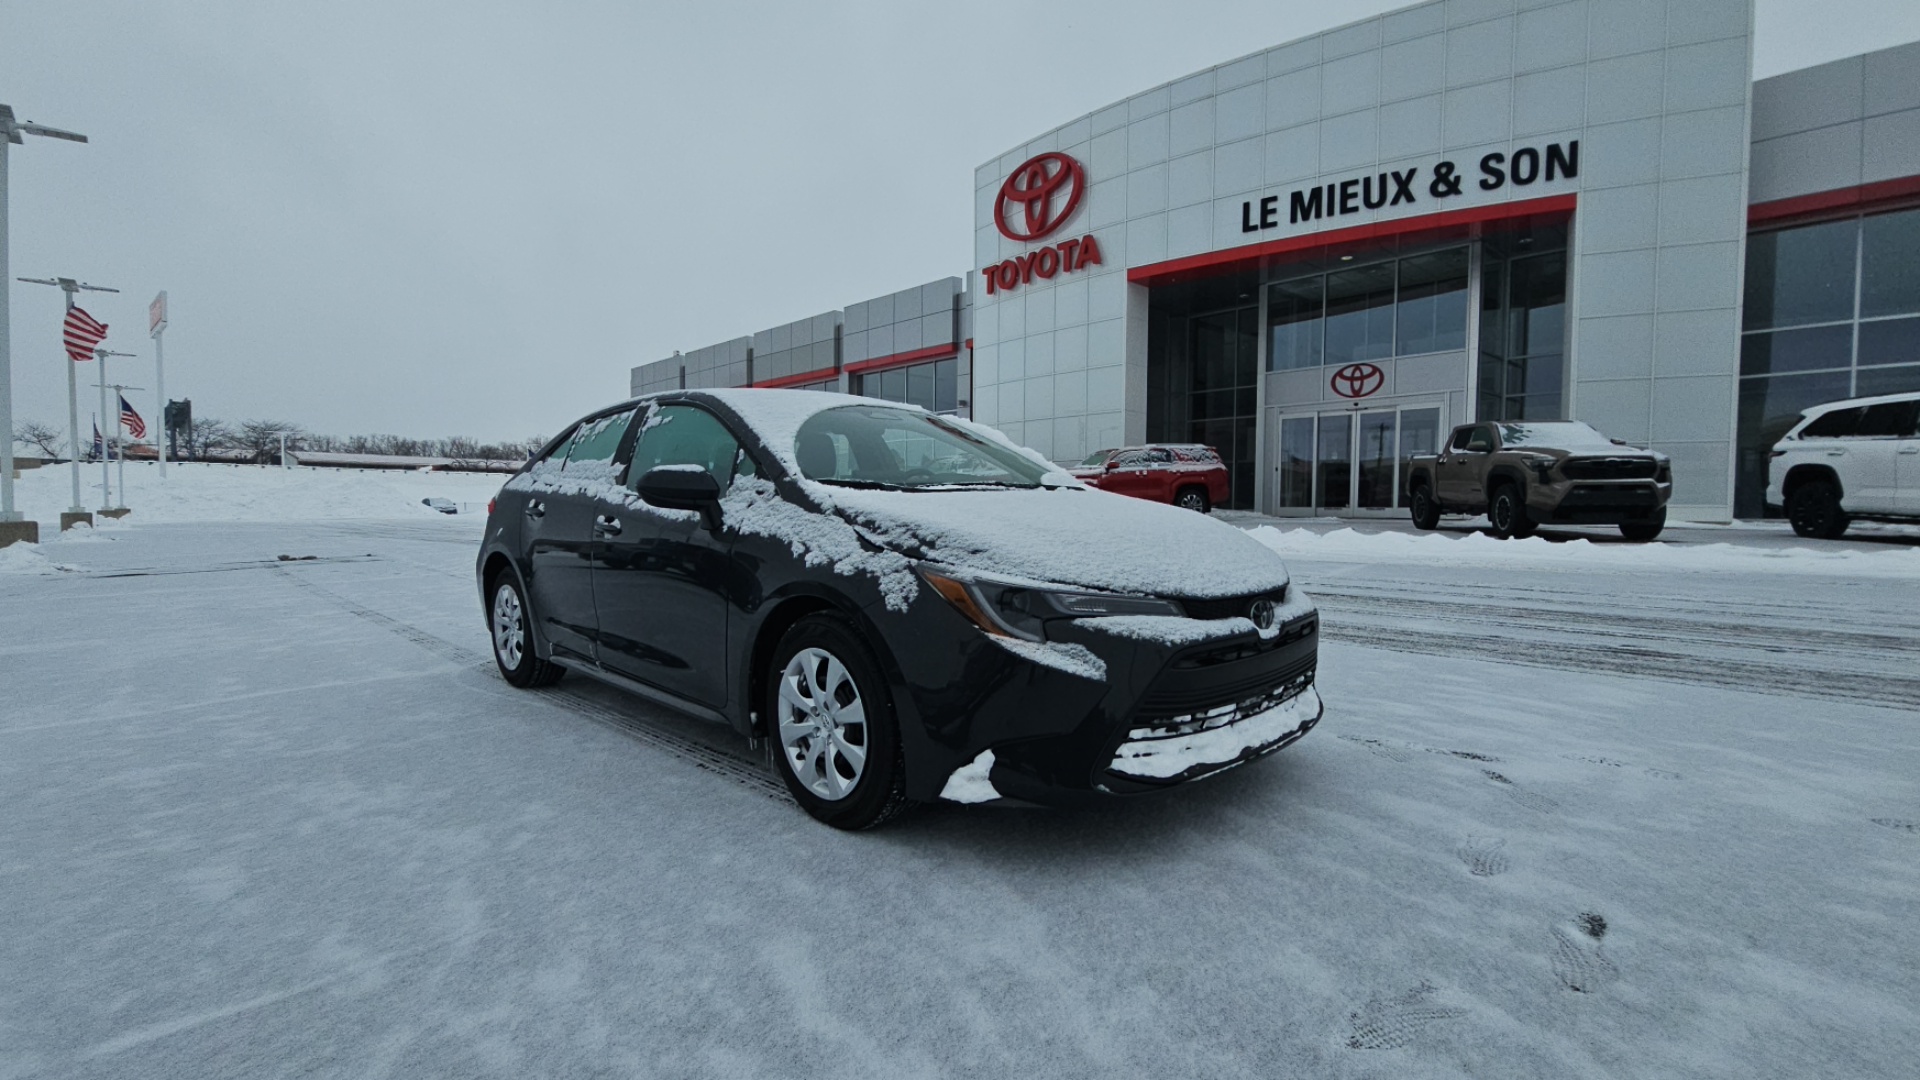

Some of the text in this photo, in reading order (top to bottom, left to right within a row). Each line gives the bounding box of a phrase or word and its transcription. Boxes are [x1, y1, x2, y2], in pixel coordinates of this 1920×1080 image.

[1242, 140, 1579, 233] LE MIEUX & SON
[982, 234, 1102, 295] TOYOTA
